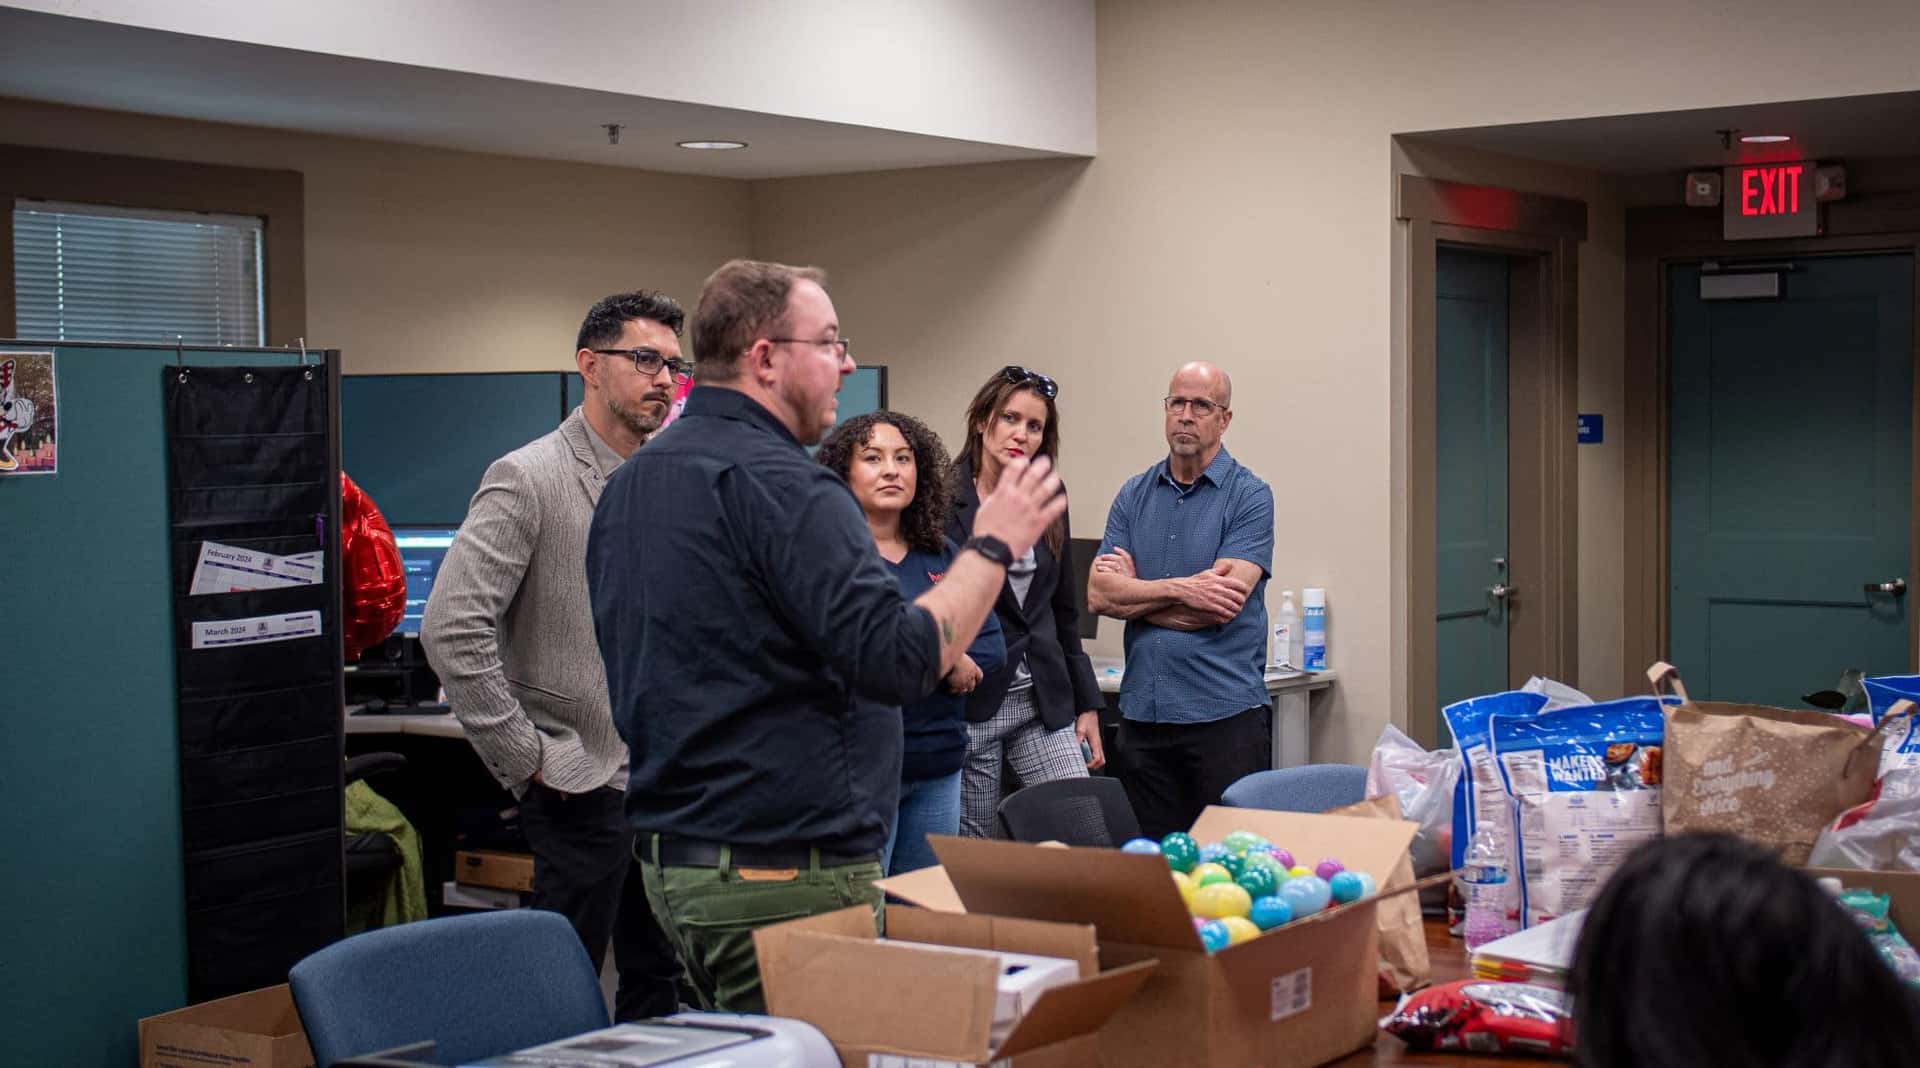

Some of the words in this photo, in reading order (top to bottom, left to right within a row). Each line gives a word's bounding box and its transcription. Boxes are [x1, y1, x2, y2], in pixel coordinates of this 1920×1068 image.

[1742, 166, 1803, 215] EXIT
[207, 549, 236, 561] February
[236, 553, 253, 563] 2024
[204, 628, 229, 636] March
[230, 626, 246, 635] 2024
[1550, 755, 1605, 769] MAKERS
[1550, 767, 1606, 781] WANTED
